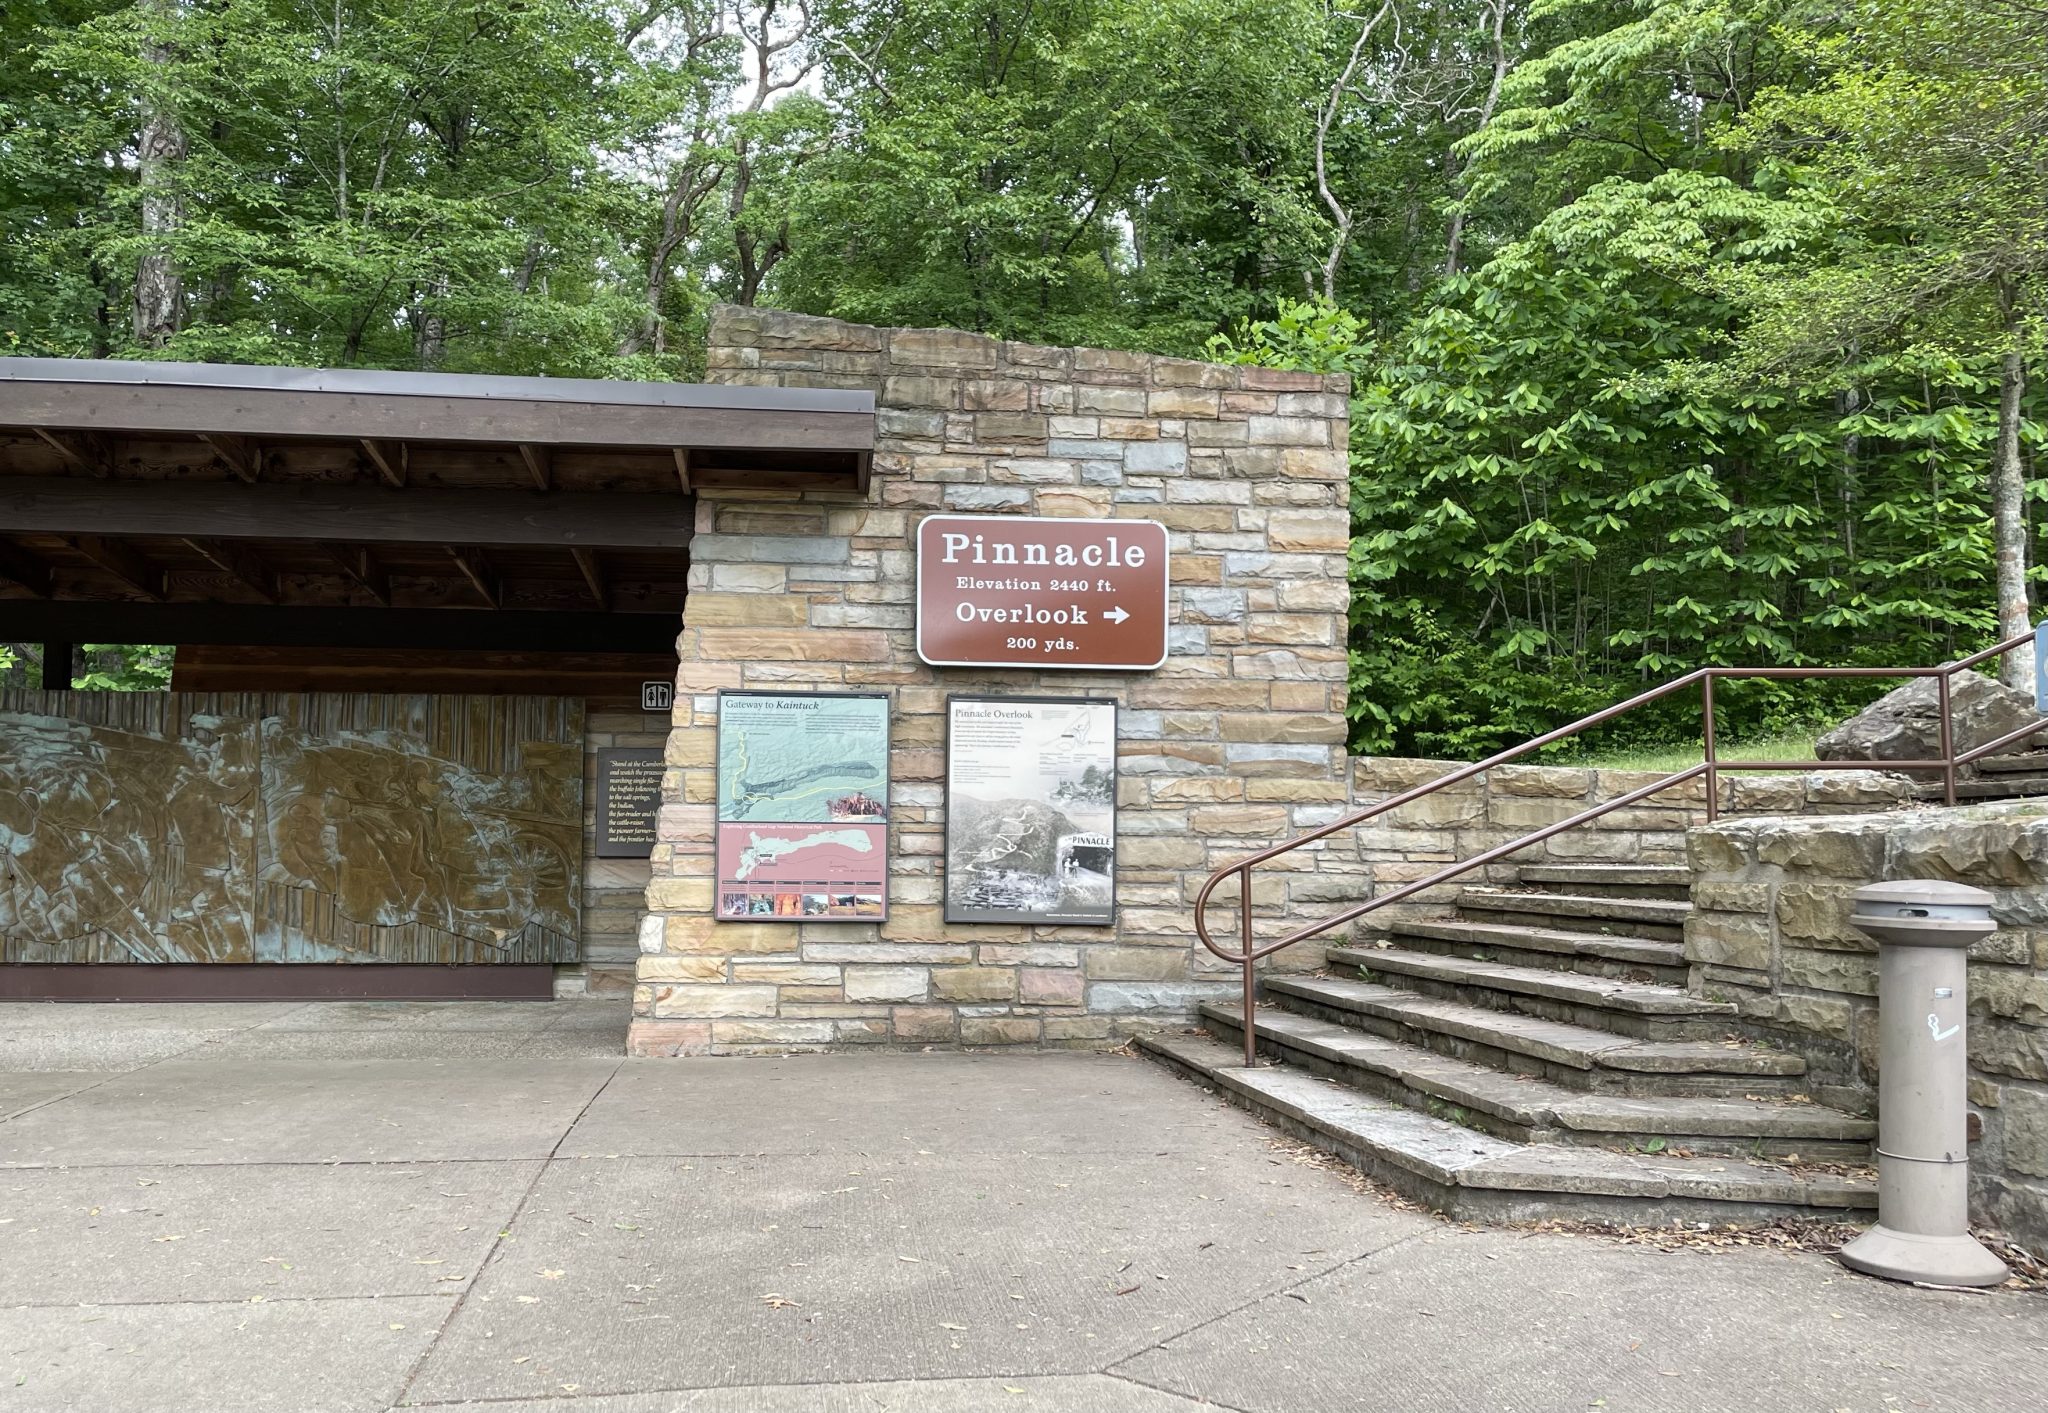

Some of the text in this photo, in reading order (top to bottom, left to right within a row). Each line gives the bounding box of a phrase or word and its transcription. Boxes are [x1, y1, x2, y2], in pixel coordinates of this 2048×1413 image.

[941, 533, 1146, 568] Pinnacle
[956, 576, 1117, 592] Elevation 2440 ft.
[956, 602, 1089, 625] Overlook
[1006, 637, 1080, 653] 200 yds.
[725, 700, 820, 711] Gateway to Kaintuck
[955, 708, 992, 718] Pinnacle
[993, 709, 1033, 719] Overlook
[1072, 835, 1110, 846] PINNACLE
